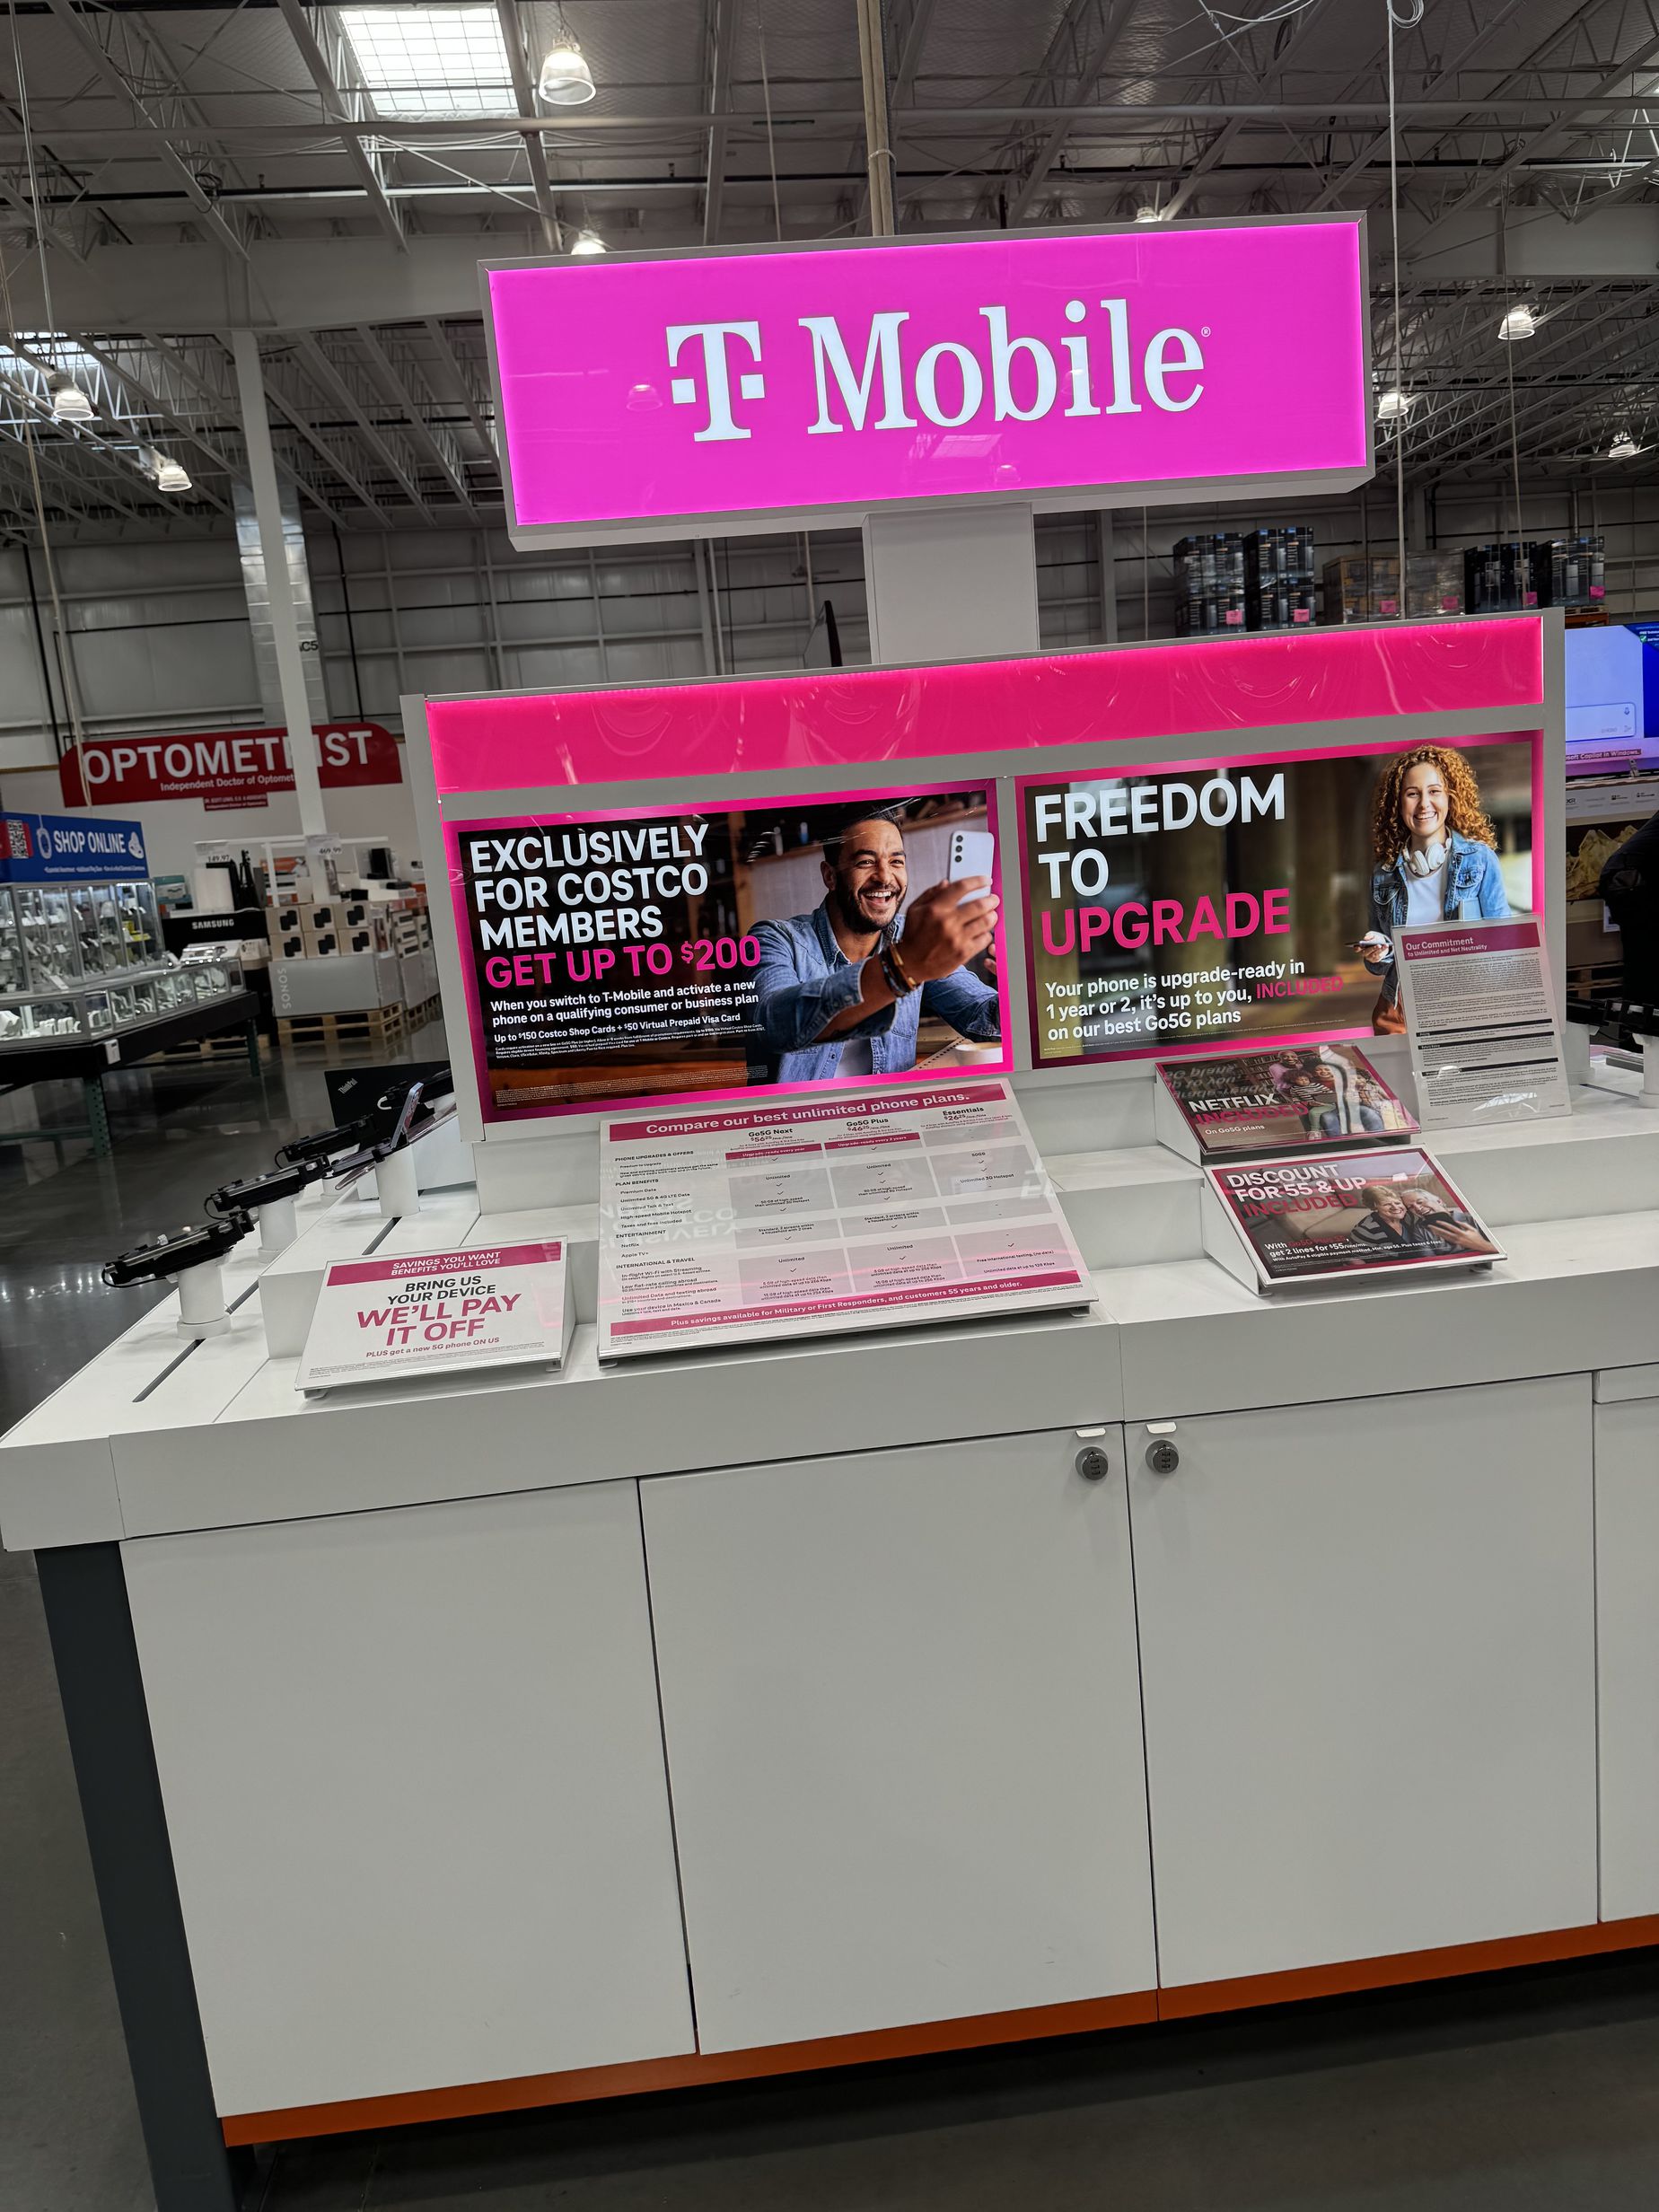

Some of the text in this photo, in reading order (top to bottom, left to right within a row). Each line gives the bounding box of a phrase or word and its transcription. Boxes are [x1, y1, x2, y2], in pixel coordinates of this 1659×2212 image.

[160, 772, 297, 792] Independent Doctor of Optomet
[1035, 773, 1286, 842] FREEDOM
[53, 830, 127, 853] SHOP ONLINE
[470, 824, 709, 873] EXCLUSIVELY
[1038, 848, 1109, 899] TO
[474, 863, 708, 912] FOR COSTCO
[192, 919, 234, 929] SAMSUNG
[479, 905, 663, 950] MEMBERS
[1041, 888, 1290, 955] UPGRADE
[1405, 936, 1474, 951] Our Commitment
[1413, 948, 1440, 956] Unlimited
[1460, 944, 1488, 952] Neutrality
[485, 935, 760, 988] GET UP TO $200
[282, 968, 292, 1010] SONOS
[1044, 958, 1304, 997] Your phone is upgrade-ready in
[489, 980, 756, 1012] When you switch to T-Mobile and activate a new
[1046, 976, 1343, 1022] 1 year or 2, it's up to you, INCLUDED
[492, 993, 759, 1028] phone on a qualifying consumer or business plan
[493, 1033, 506, 1043] Up
[506, 1033, 517, 1041] to
[517, 1031, 537, 1040] $150
[537, 1029, 568, 1039] Costco
[568, 1027, 591, 1036] Shop
[591, 1024, 616, 1034] Cards
[623, 1022, 638, 1031] $50
[638, 1019, 668, 1030] Virtual
[668, 1016, 701, 1027] Prepaid
[701, 1014, 720, 1024] Visa
[720, 1012, 741, 1023] Card
[1048, 1027, 1068, 1040] on
[1072, 1023, 1101, 1038] our
[1103, 1016, 1142, 1035] best
[1145, 1011, 1191, 1031] Go5G
[1196, 1009, 1241, 1029] plans
[645, 1091, 970, 1138] Compare our best unlimited phone plans.
[943, 1106, 984, 1116] Essentials
[1189, 1093, 1279, 1113] NETFLIX
[1196, 1103, 1308, 1125] INCLUDED
[749, 1127, 793, 1137] Go5G Next
[846, 1117, 889, 1128] Go5G Plus
[1226, 1164, 1339, 1189] DISCOUNT
[1235, 1176, 1366, 1203] FOR 55 & UP
[1242, 1194, 1357, 1217] INCLUDED
[616, 1230, 666, 1239] ENTERTAINMENT
[1264, 1241, 1287, 1250] With
[391, 1258, 500, 1275] BENEFITS YOU'LL LOVE
[392, 1251, 500, 1271] SAVINGS YOU WANT
[388, 1284, 496, 1304] YOUR DEVICE
[405, 1276, 481, 1292] BRING US
[357, 1294, 522, 1328] WE'LL PAY
[690, 1316, 721, 1324] savings
[724, 1312, 759, 1321] available
[775, 1305, 806, 1315] Military
[838, 1297, 887, 1308] Responders,
[905, 1289, 946, 1300] customers
[999, 1280, 1022, 1288] older.
[387, 1318, 485, 1346] IT OFF
[445, 1341, 471, 1349] phone
